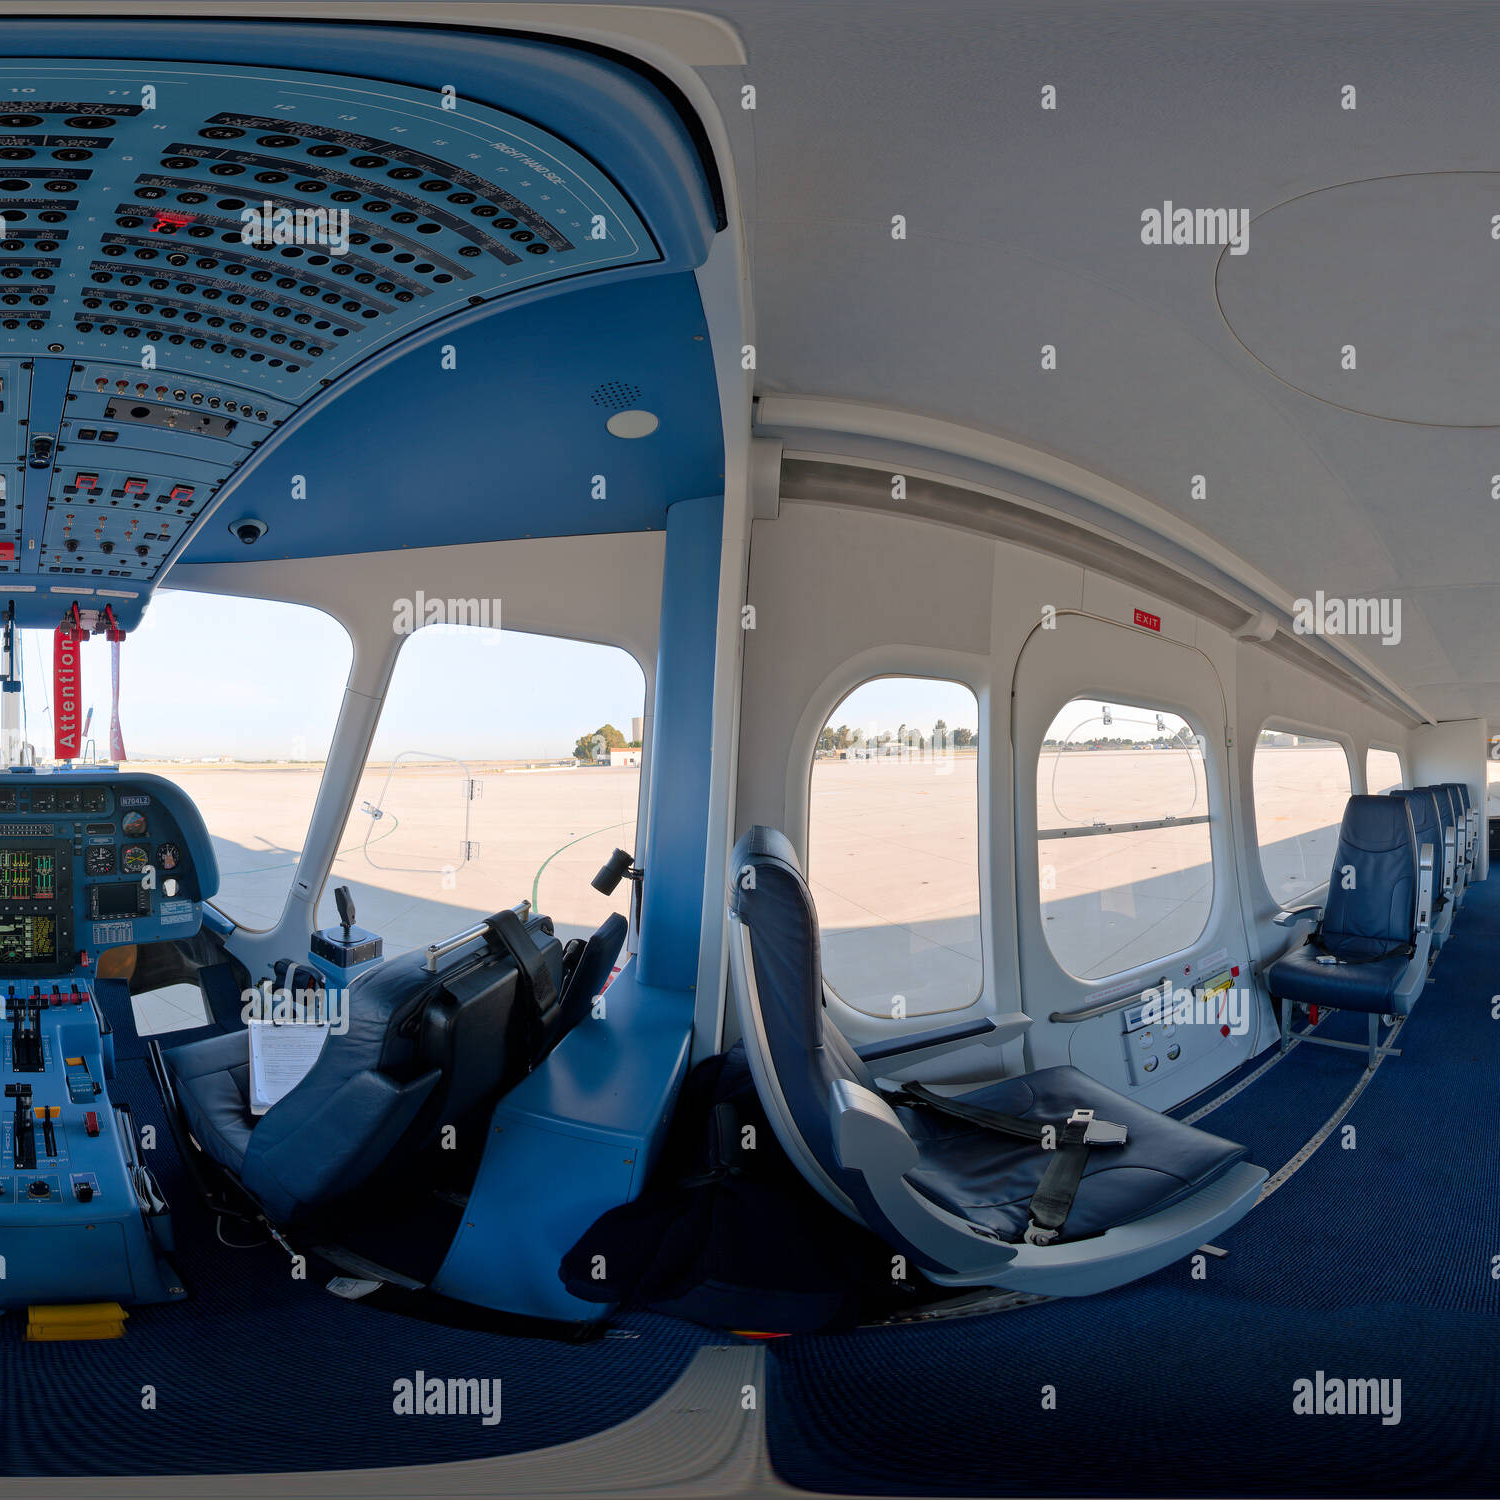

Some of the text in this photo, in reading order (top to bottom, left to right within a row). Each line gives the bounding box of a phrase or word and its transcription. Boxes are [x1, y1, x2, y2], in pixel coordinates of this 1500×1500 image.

[489, 142, 566, 185] RIGHT HAND SIDE
[1136, 613, 1157, 627] EXIT
[58, 640, 76, 748] Attention
